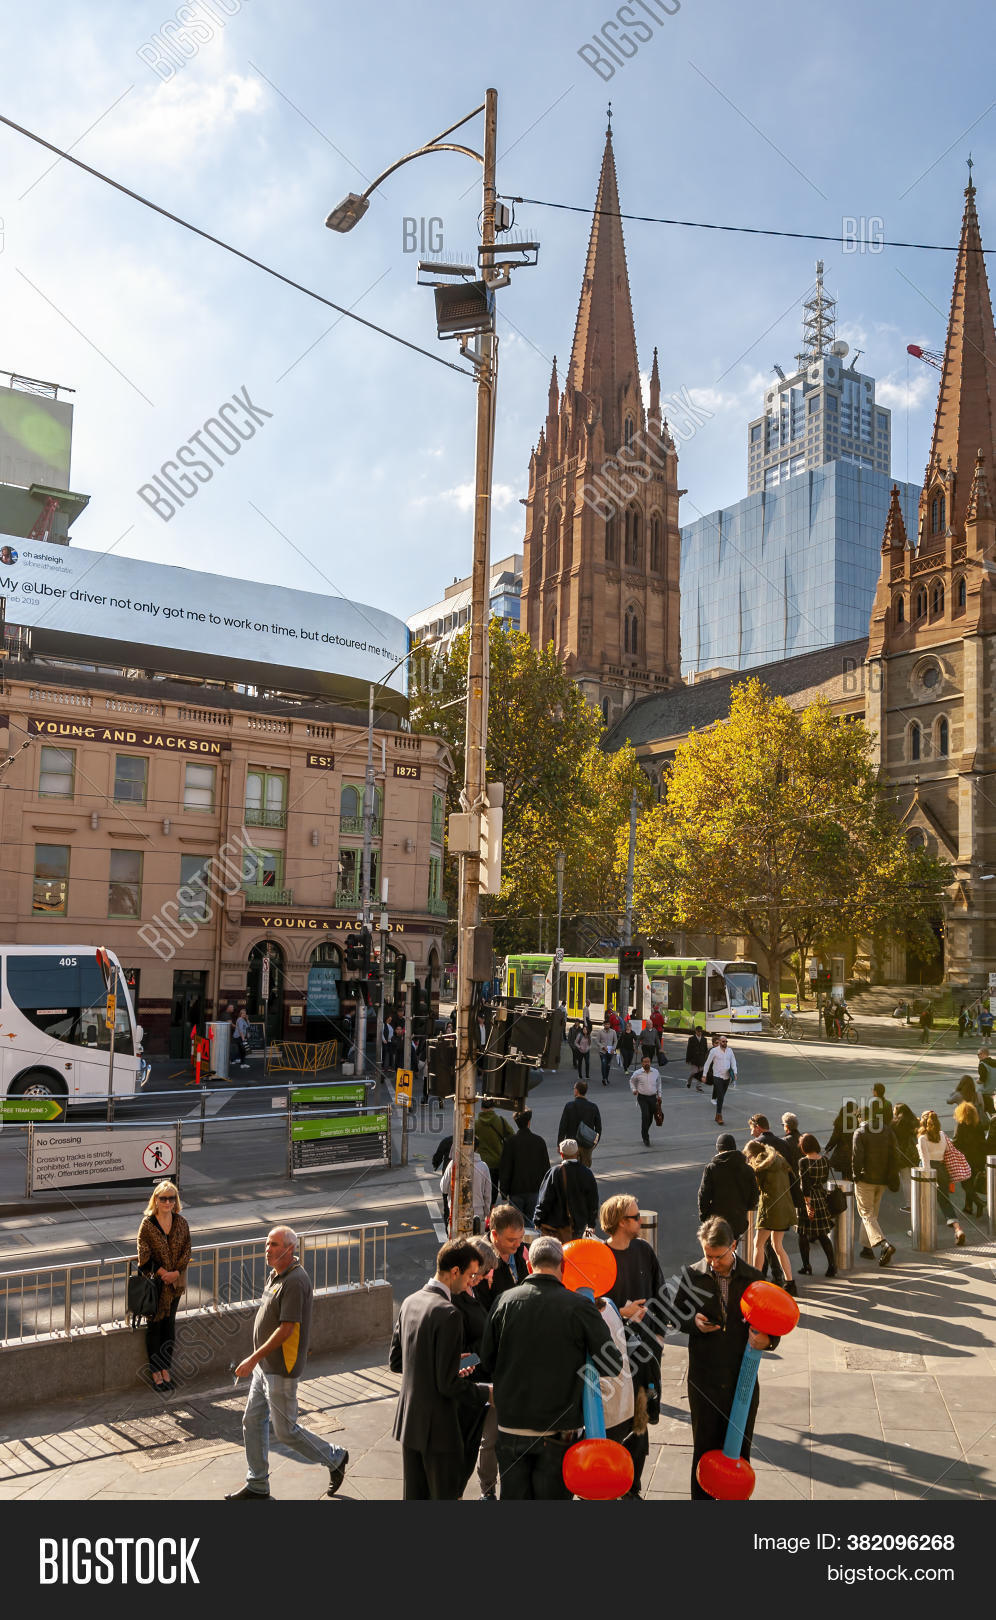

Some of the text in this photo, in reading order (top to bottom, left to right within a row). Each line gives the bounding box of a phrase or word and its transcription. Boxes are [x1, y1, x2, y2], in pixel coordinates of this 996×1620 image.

[0, 577, 19, 592] My
[21, 581, 66, 598] @Uber
[70, 590, 107, 605] driver
[110, 597, 131, 609] not
[133, 601, 160, 617] only
[162, 606, 185, 619] got
[186, 612, 206, 622] me
[209, 613, 221, 625] to
[223, 618, 251, 630] work
[253, 622, 269, 633] on
[270, 624, 298, 638] time,
[300, 628, 319, 641] but
[321, 632, 367, 651] detoured
[368, 644, 381, 656] me
[35, 720, 221, 754] YOUNG AND JACKSON
[396, 766, 418, 777] 1875
[261, 917, 405, 932] YOUNG & JACSON
[59, 957, 77, 966] 405
[49, 1136, 82, 1145] Crossing
[36, 1156, 66, 1165] Crossing
[66, 1153, 86, 1162] tracks
[93, 1150, 113, 1158] strictly
[37, 1163, 70, 1172] prohibited.
[73, 1161, 94, 1169] Heavy
[57, 1169, 89, 1178] Offenders
